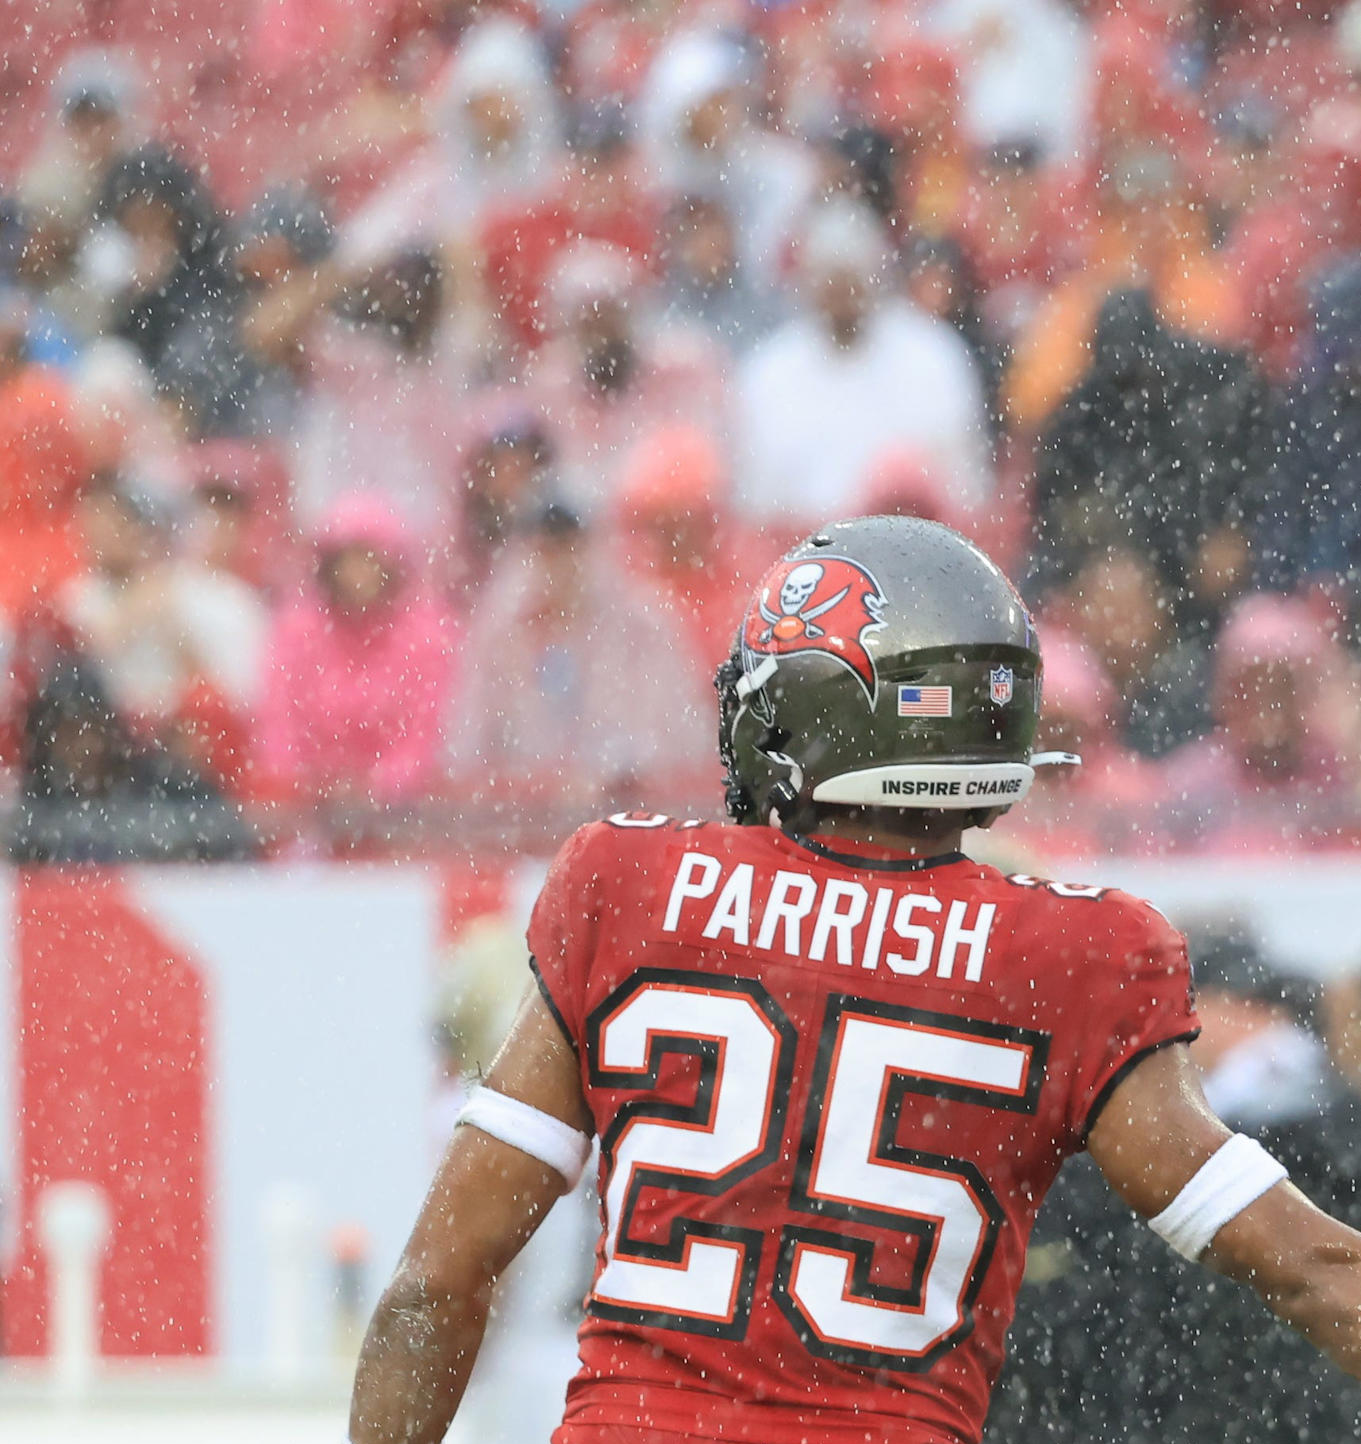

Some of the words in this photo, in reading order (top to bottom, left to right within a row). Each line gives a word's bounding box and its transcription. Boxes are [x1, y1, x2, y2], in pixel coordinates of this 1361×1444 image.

[994, 683, 1010, 698] NFL
[882, 780, 961, 796] INSPIRE
[966, 779, 1022, 795] CHANGE
[662, 852, 997, 982] PARRISH
[585, 966, 1050, 1374] 25
